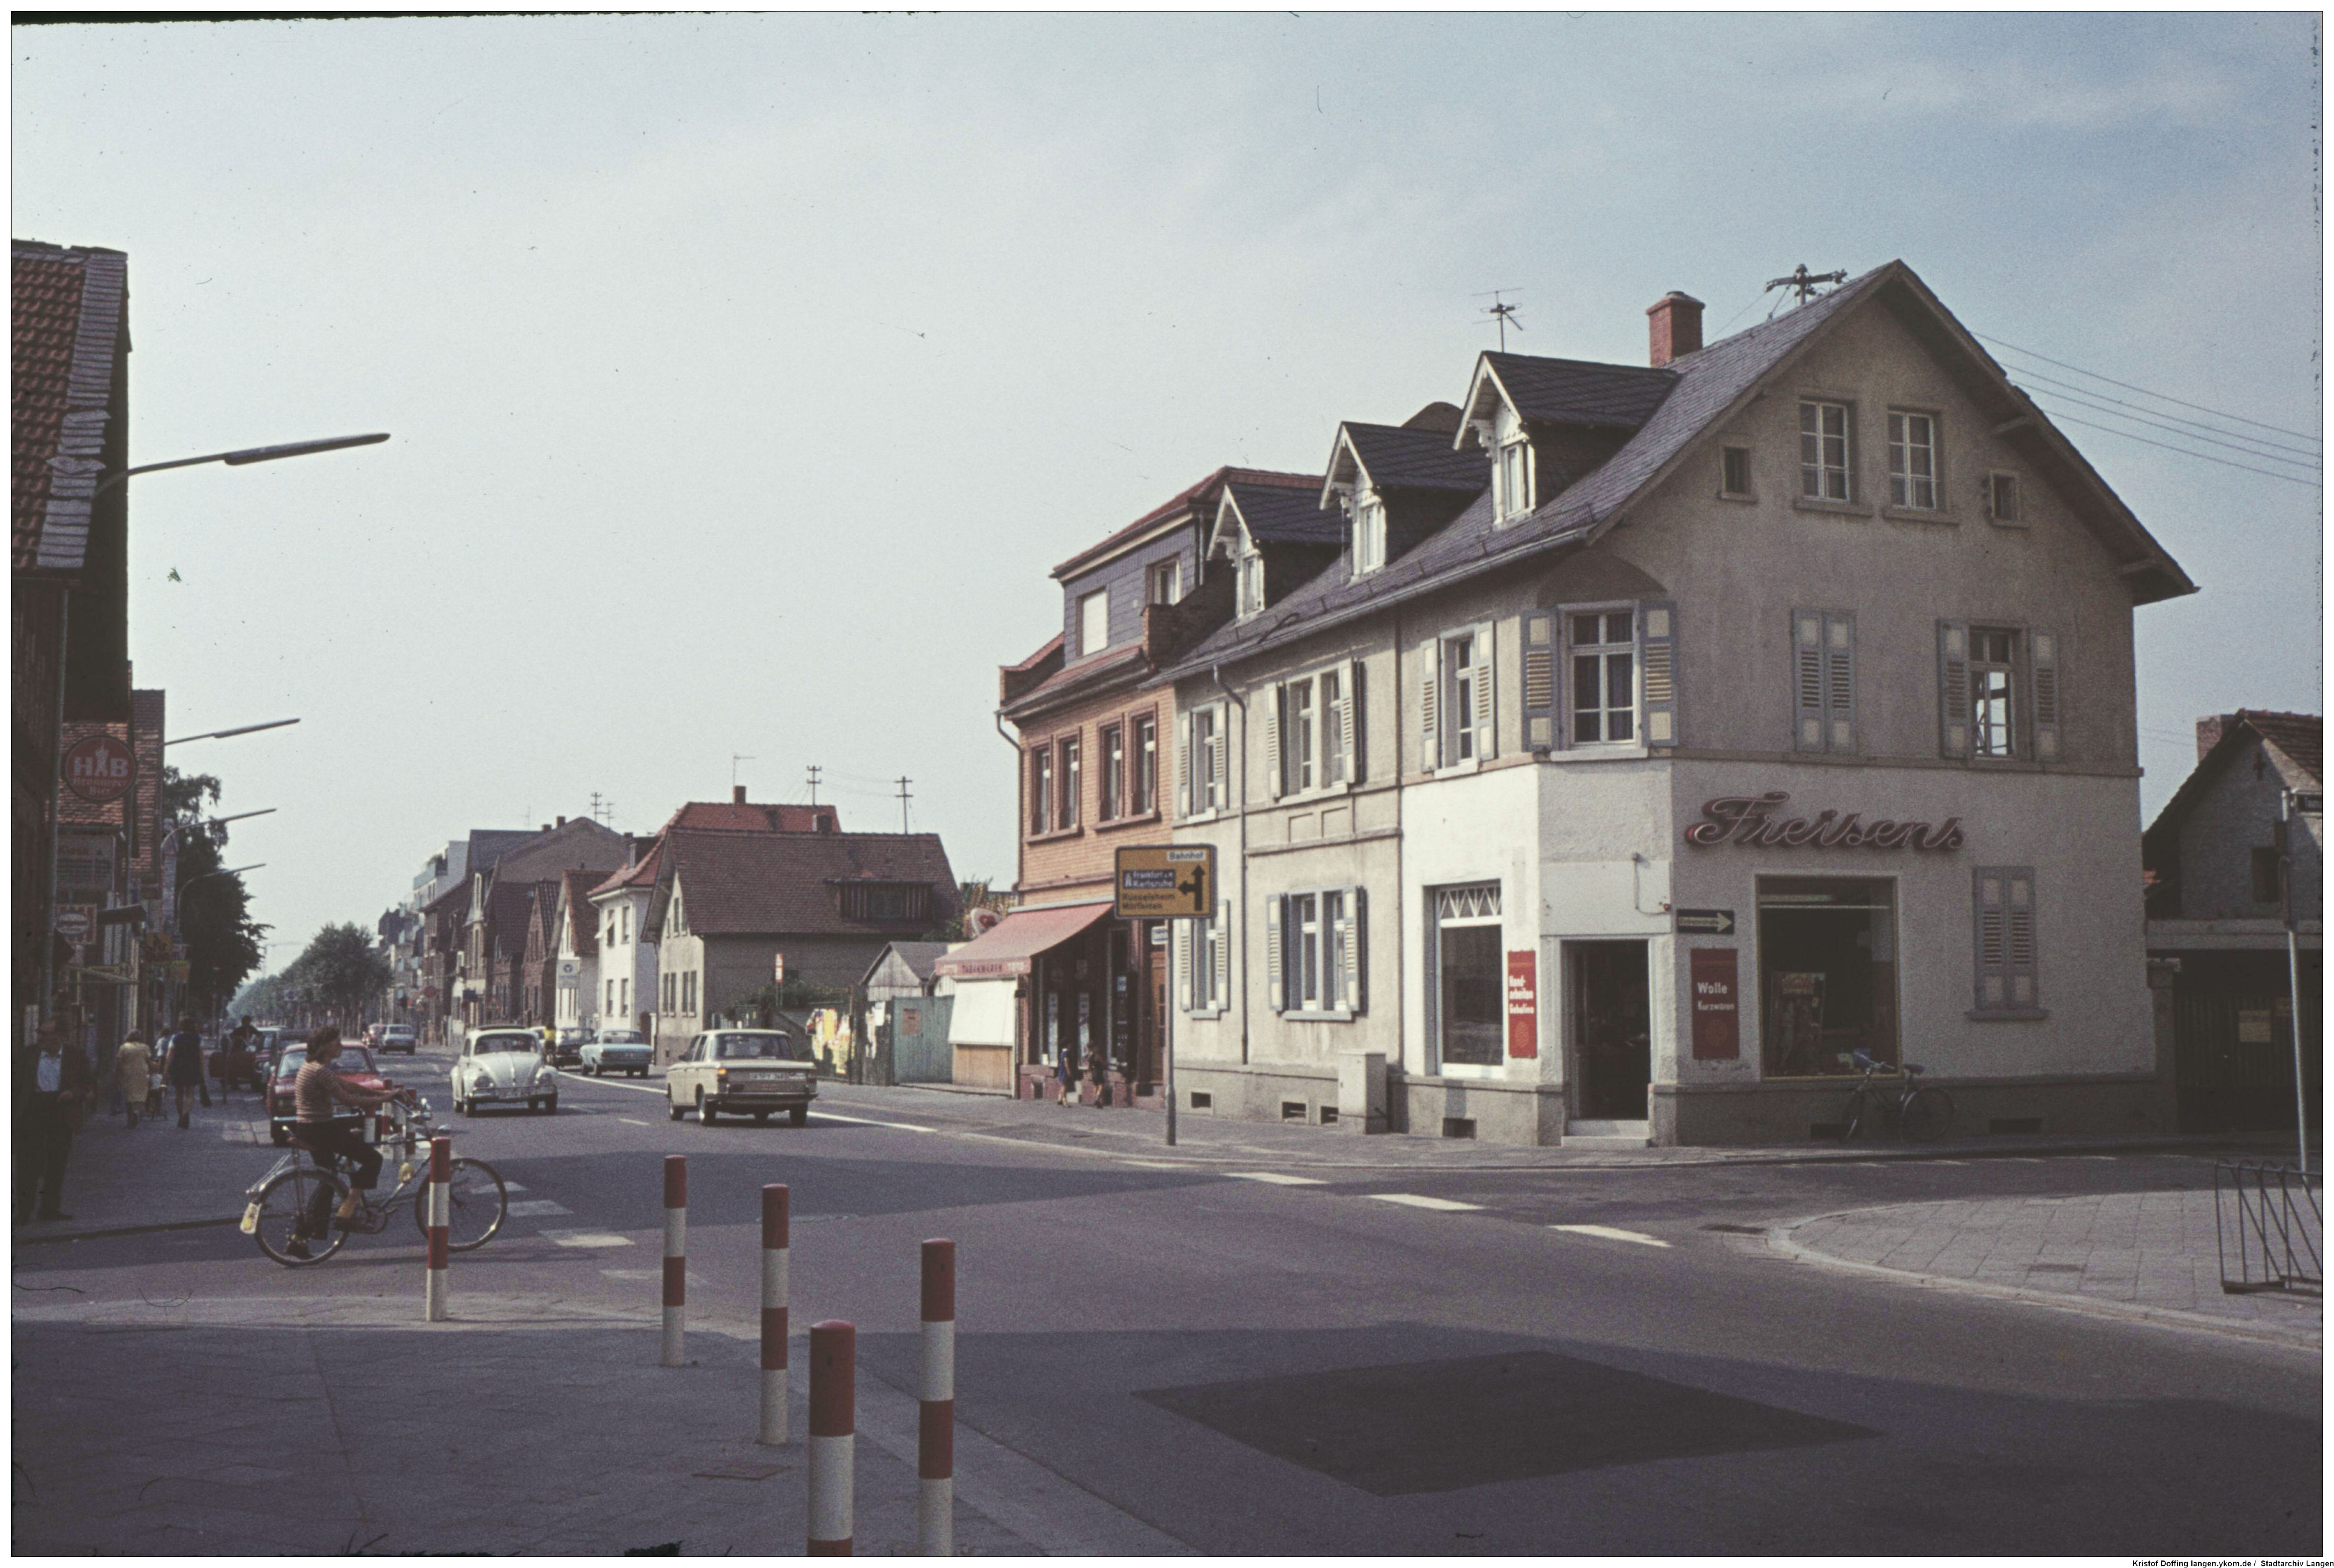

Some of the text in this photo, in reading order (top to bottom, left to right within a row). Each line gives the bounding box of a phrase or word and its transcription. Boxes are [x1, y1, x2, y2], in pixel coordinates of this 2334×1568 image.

[1685, 791, 1964, 852] Freisens
[1169, 852, 1203, 860] Bahnhof
[1133, 880, 1173, 888] Karlsruhe
[1697, 982, 1727, 994] Wolle
[1697, 1000, 1735, 1010] Kurzwaren
